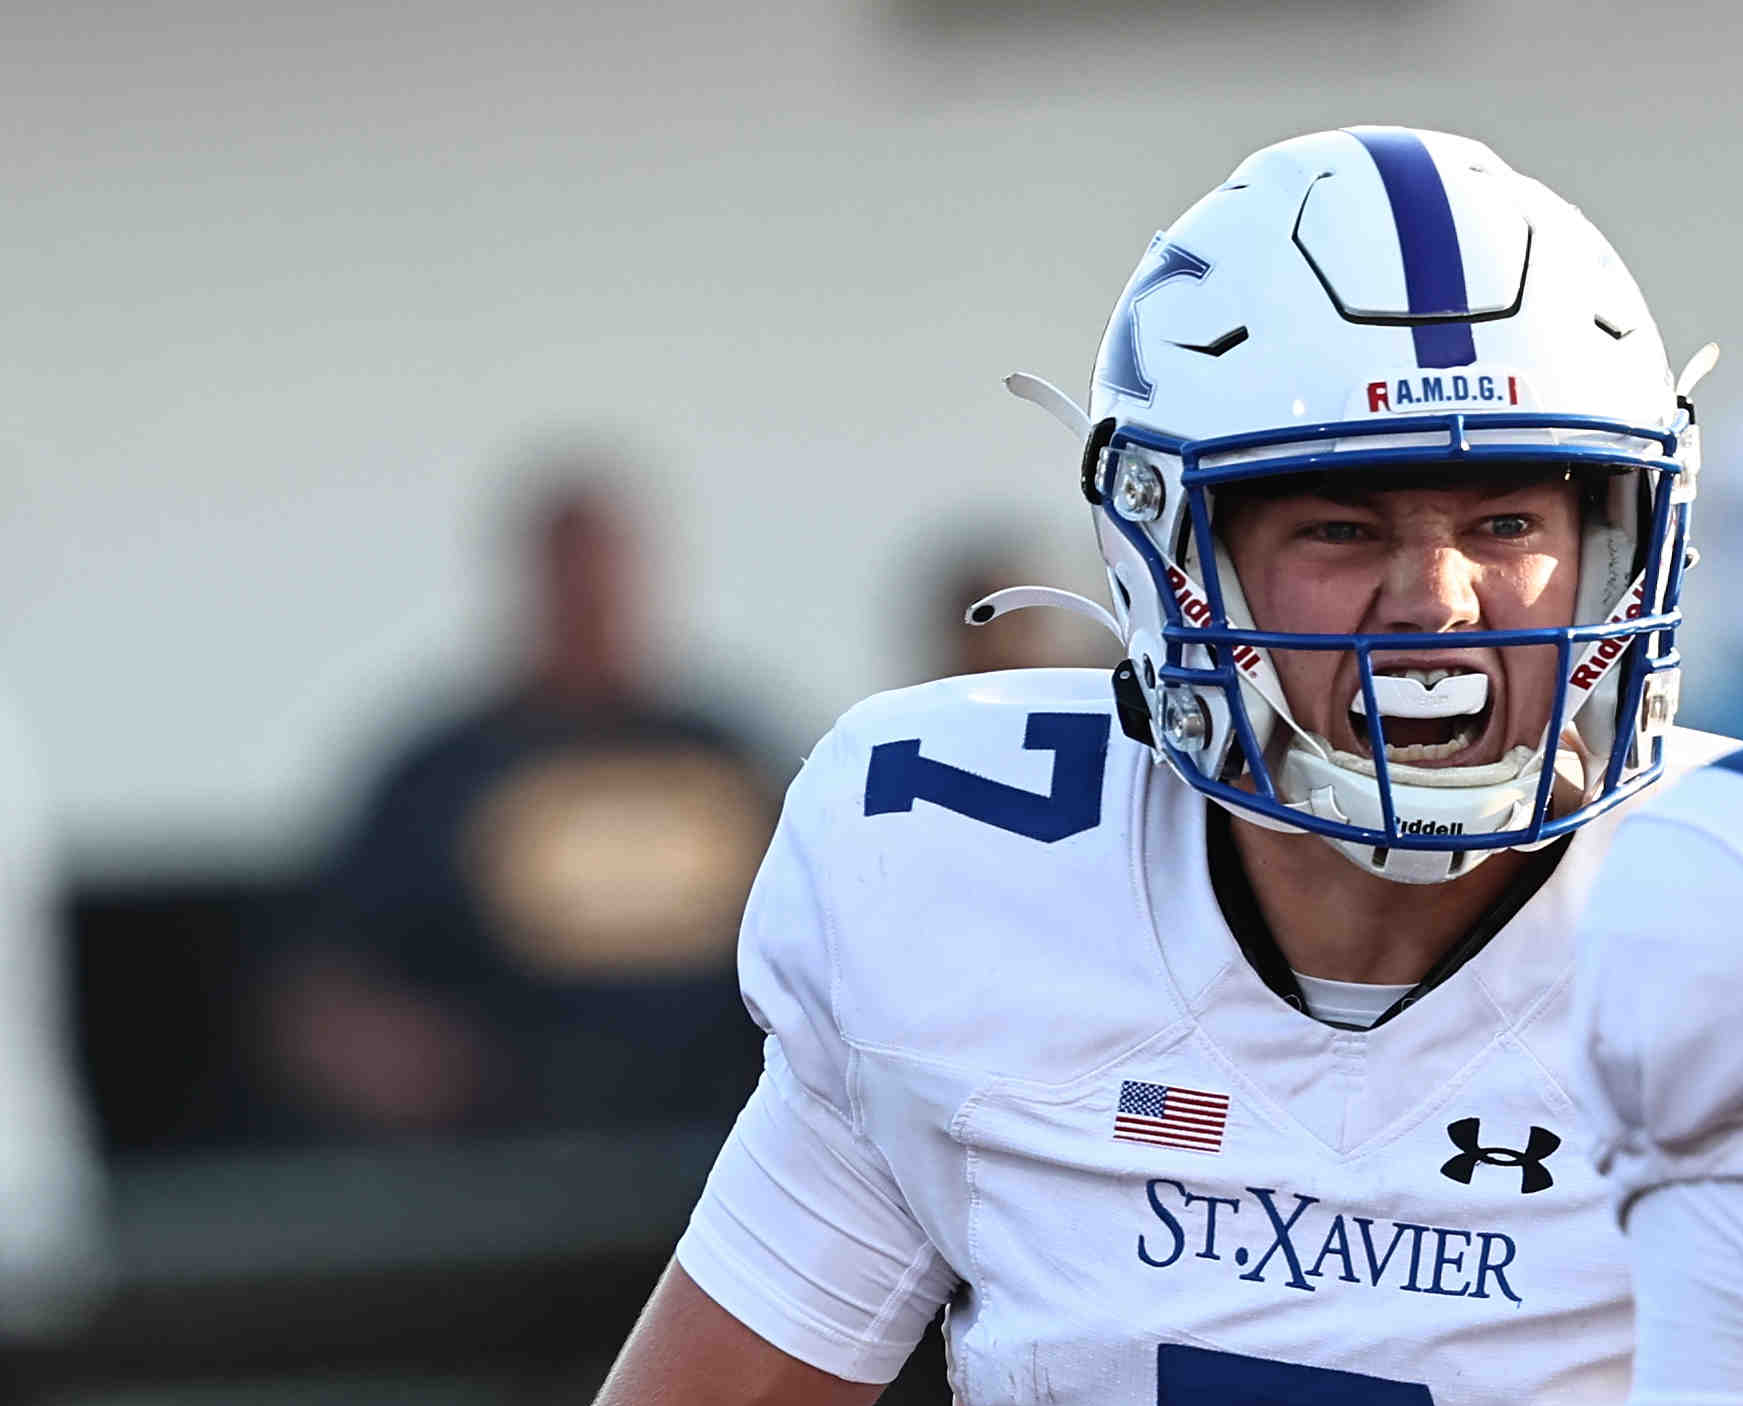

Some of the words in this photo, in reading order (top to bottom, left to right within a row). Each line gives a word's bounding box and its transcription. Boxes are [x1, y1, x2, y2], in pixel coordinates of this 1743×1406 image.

[1396, 375, 1503, 405] A.M.D.G.
[863, 711, 1112, 844] 7
[1395, 816, 1464, 835] iddell
